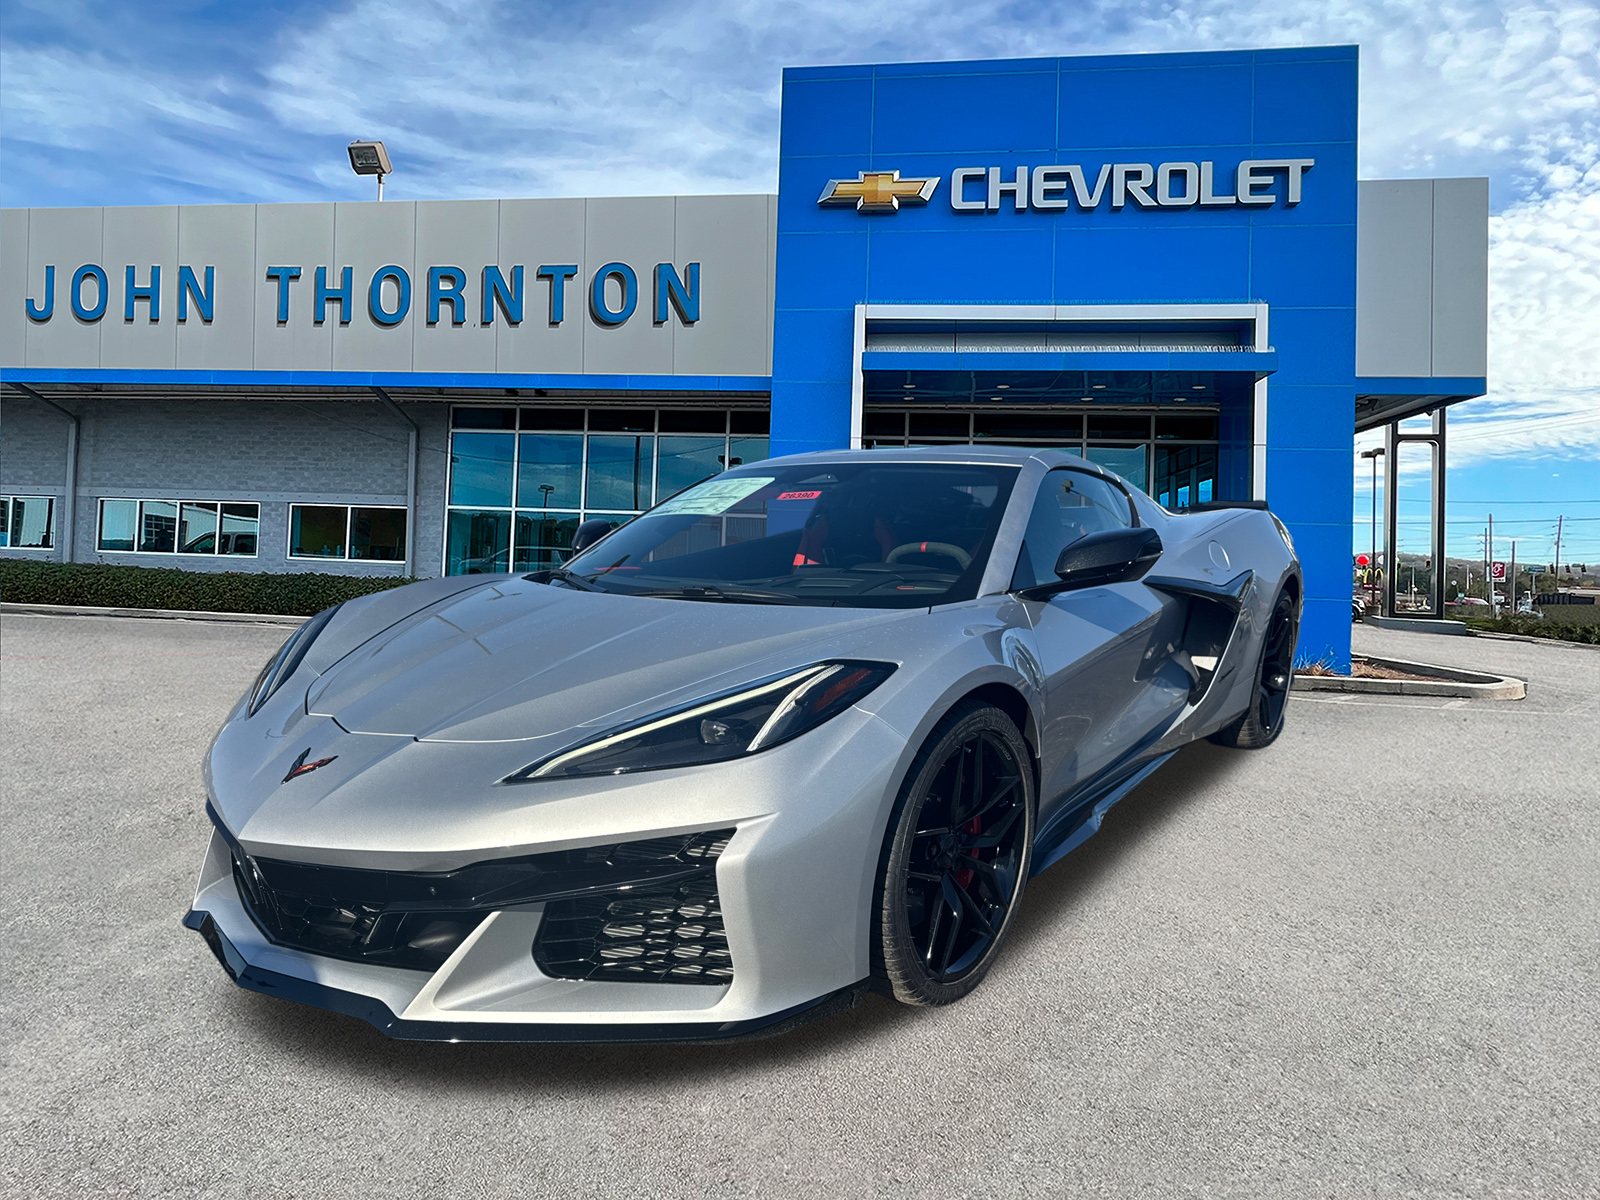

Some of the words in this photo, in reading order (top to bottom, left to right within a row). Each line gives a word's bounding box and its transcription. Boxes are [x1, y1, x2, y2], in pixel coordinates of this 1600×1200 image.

[950, 158, 1316, 214] CHEVROLET
[25, 264, 216, 324] JOHN
[266, 261, 702, 327] THORNTON
